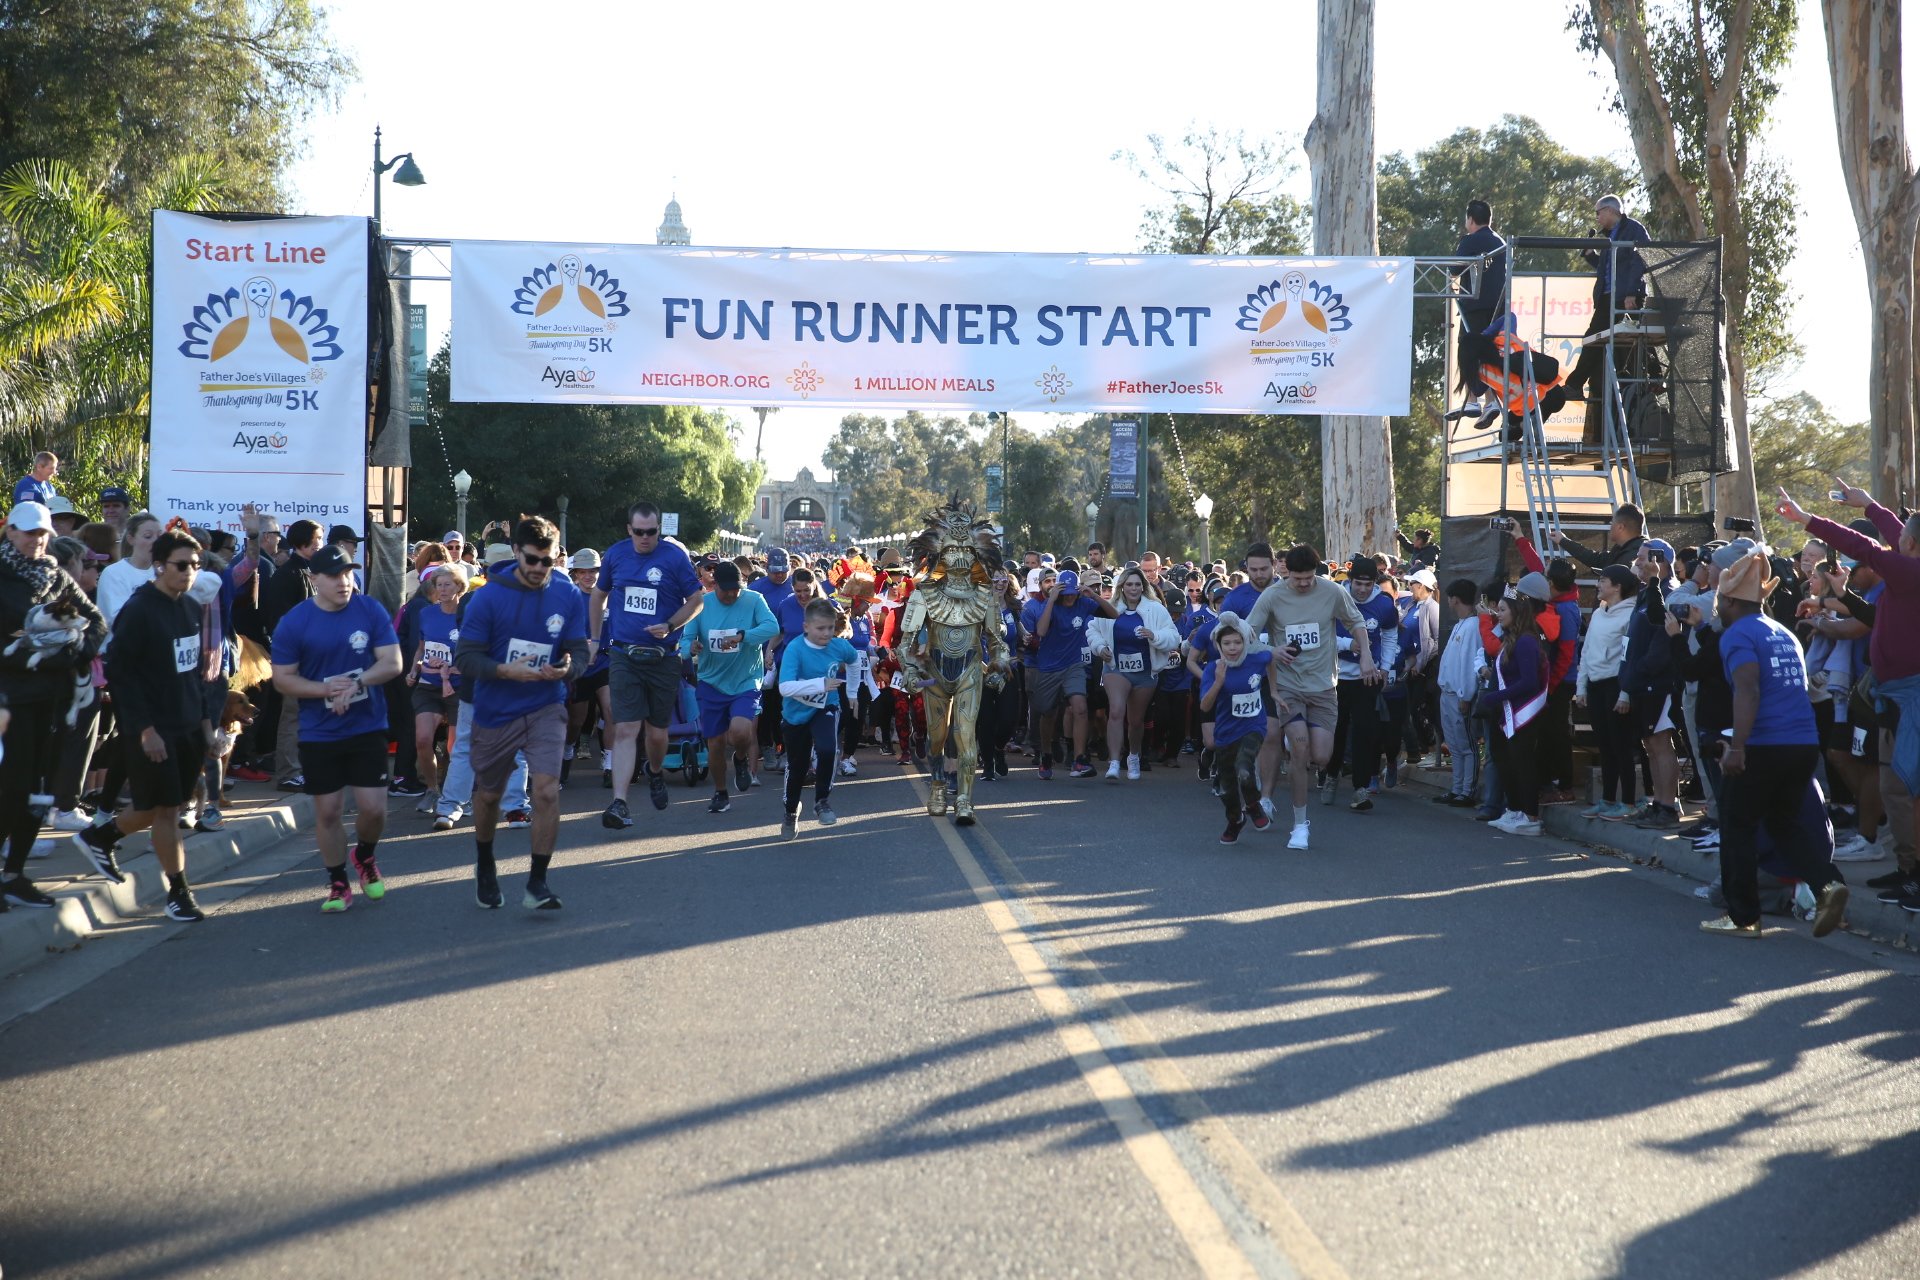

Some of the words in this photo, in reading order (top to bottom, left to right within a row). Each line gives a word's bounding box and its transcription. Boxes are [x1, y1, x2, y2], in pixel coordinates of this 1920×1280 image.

[185, 238, 255, 263] Start
[264, 241, 326, 264] Line
[527, 323, 551, 331] Father
[552, 324, 572, 332] Joe's
[572, 325, 603, 334] Villages
[662, 297, 774, 341] FUN
[791, 300, 1020, 346] RUNNER
[1036, 304, 1211, 347] START
[528, 340, 572, 350] Thanksgiving
[573, 339, 587, 349] Day
[588, 337, 613, 352] 5K
[1251, 339, 1275, 347] Father
[1295, 340, 1326, 349] Villages
[1311, 352, 1335, 367] 5K
[200, 371, 234, 382] Father
[235, 372, 262, 382] Joe's
[263, 373, 306, 384] Villages
[541, 365, 576, 388] Aya
[641, 373, 770, 389] NEIGHBOR.ORG
[853, 377, 862, 390] 1
[867, 377, 938, 391] MILLION
[941, 378, 995, 392] MEALS
[1107, 380, 1223, 396] #FatherJoes5k
[1263, 381, 1298, 403] Aya
[202, 394, 263, 409] Thanksgiving
[265, 392, 283, 406] Day
[286, 389, 319, 411] 5K
[232, 431, 269, 453] Aya
[167, 498, 215, 511] Thank
[218, 503, 245, 514] you
[274, 501, 329, 516] helping
[333, 504, 349, 514] us
[216, 520, 222, 530] 1
[626, 595, 655, 611] 4368
[1119, 660, 1142, 670] 1423
[1233, 698, 1261, 715] 4214
